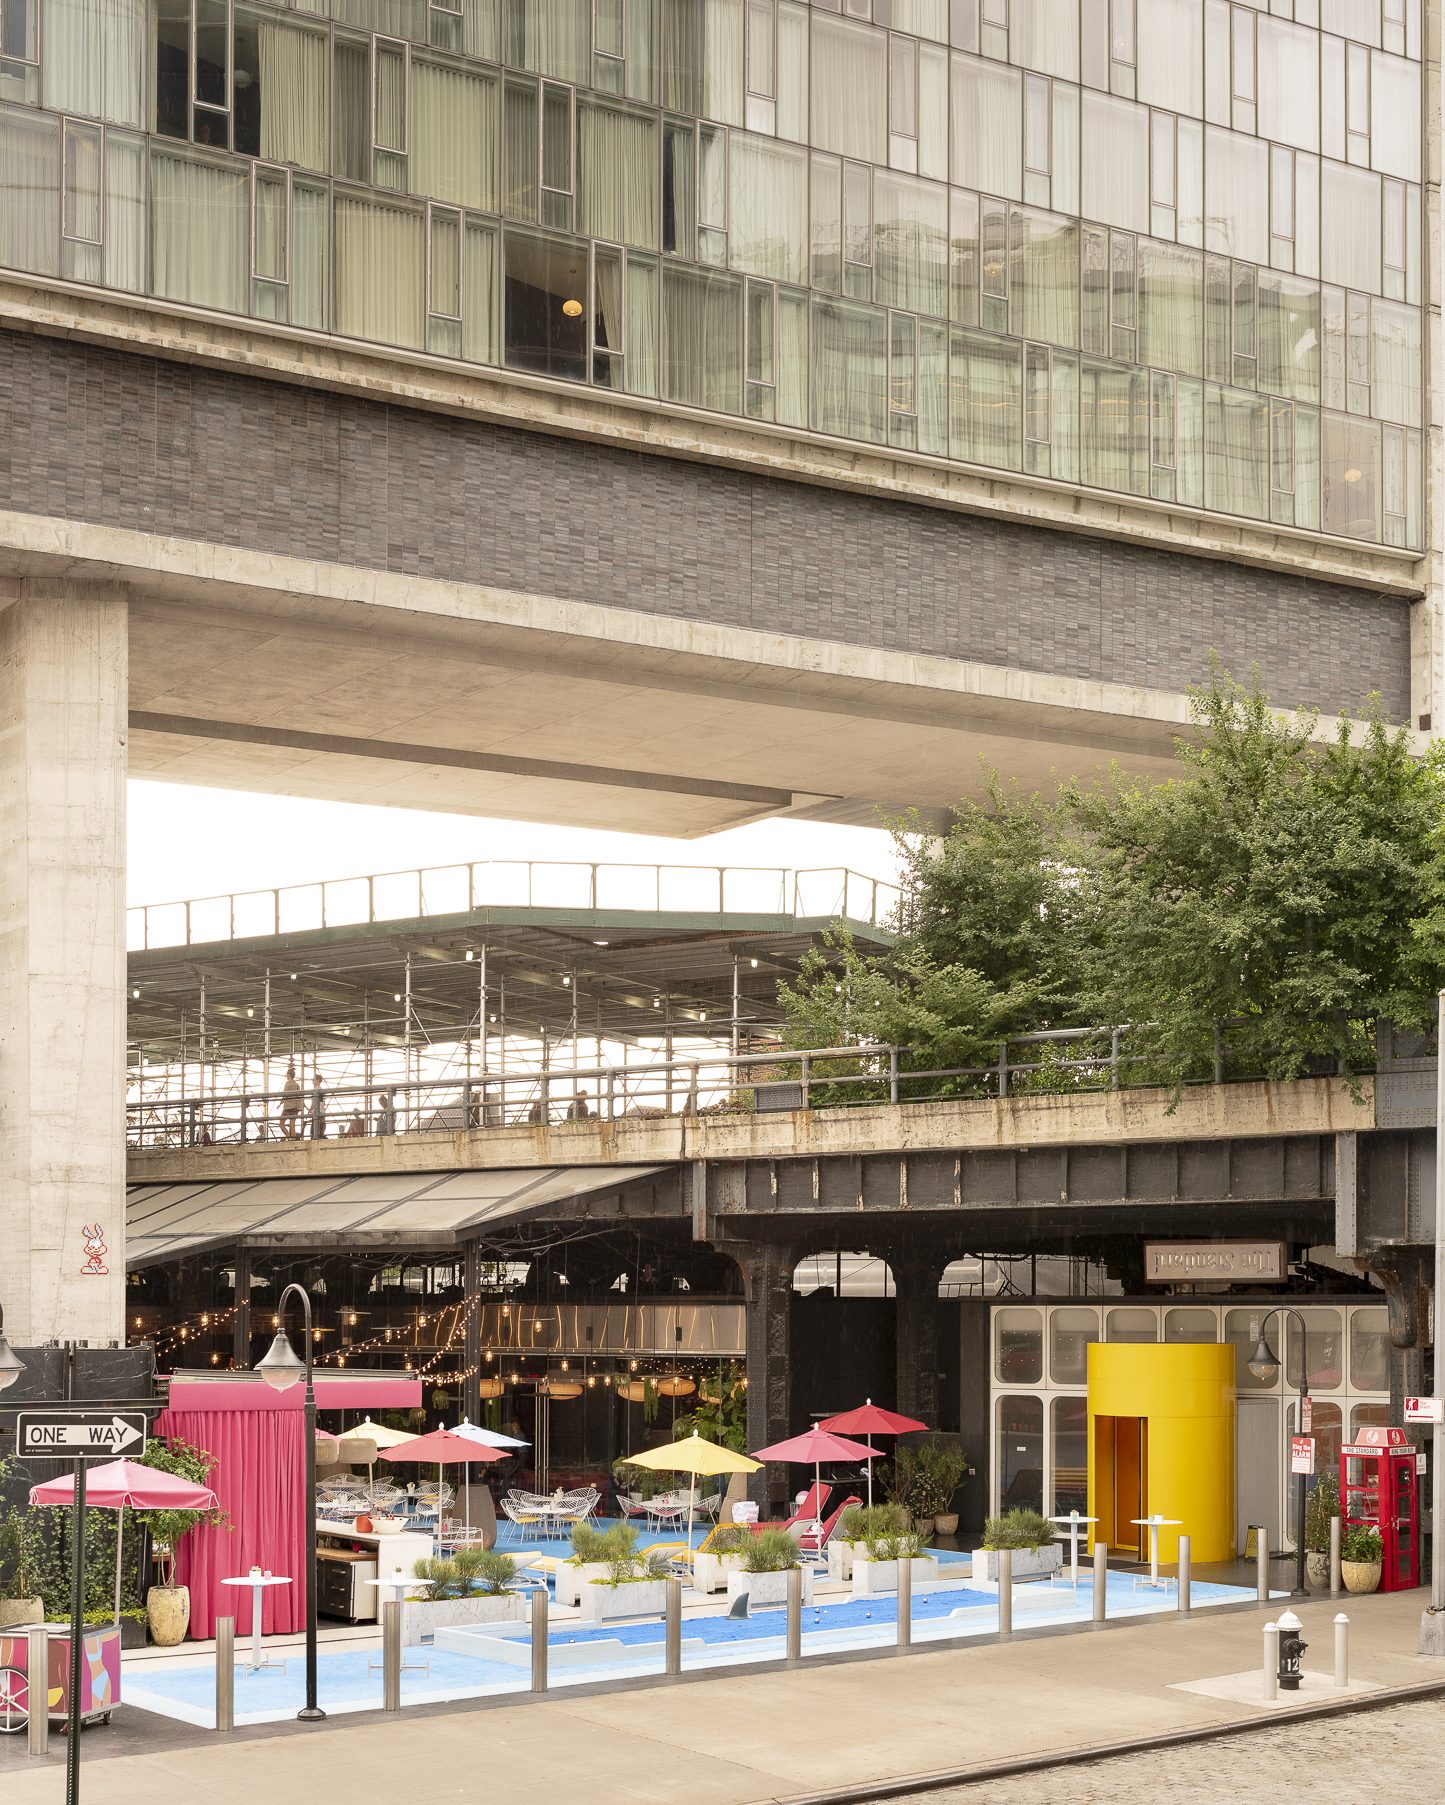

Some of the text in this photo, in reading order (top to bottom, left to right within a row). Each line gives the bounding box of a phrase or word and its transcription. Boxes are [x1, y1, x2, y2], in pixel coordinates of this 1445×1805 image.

[1154, 1251, 1274, 1274] The Standard
[30, 1427, 128, 1443] ONE WAY
[1287, 1658, 1299, 1672] 12
